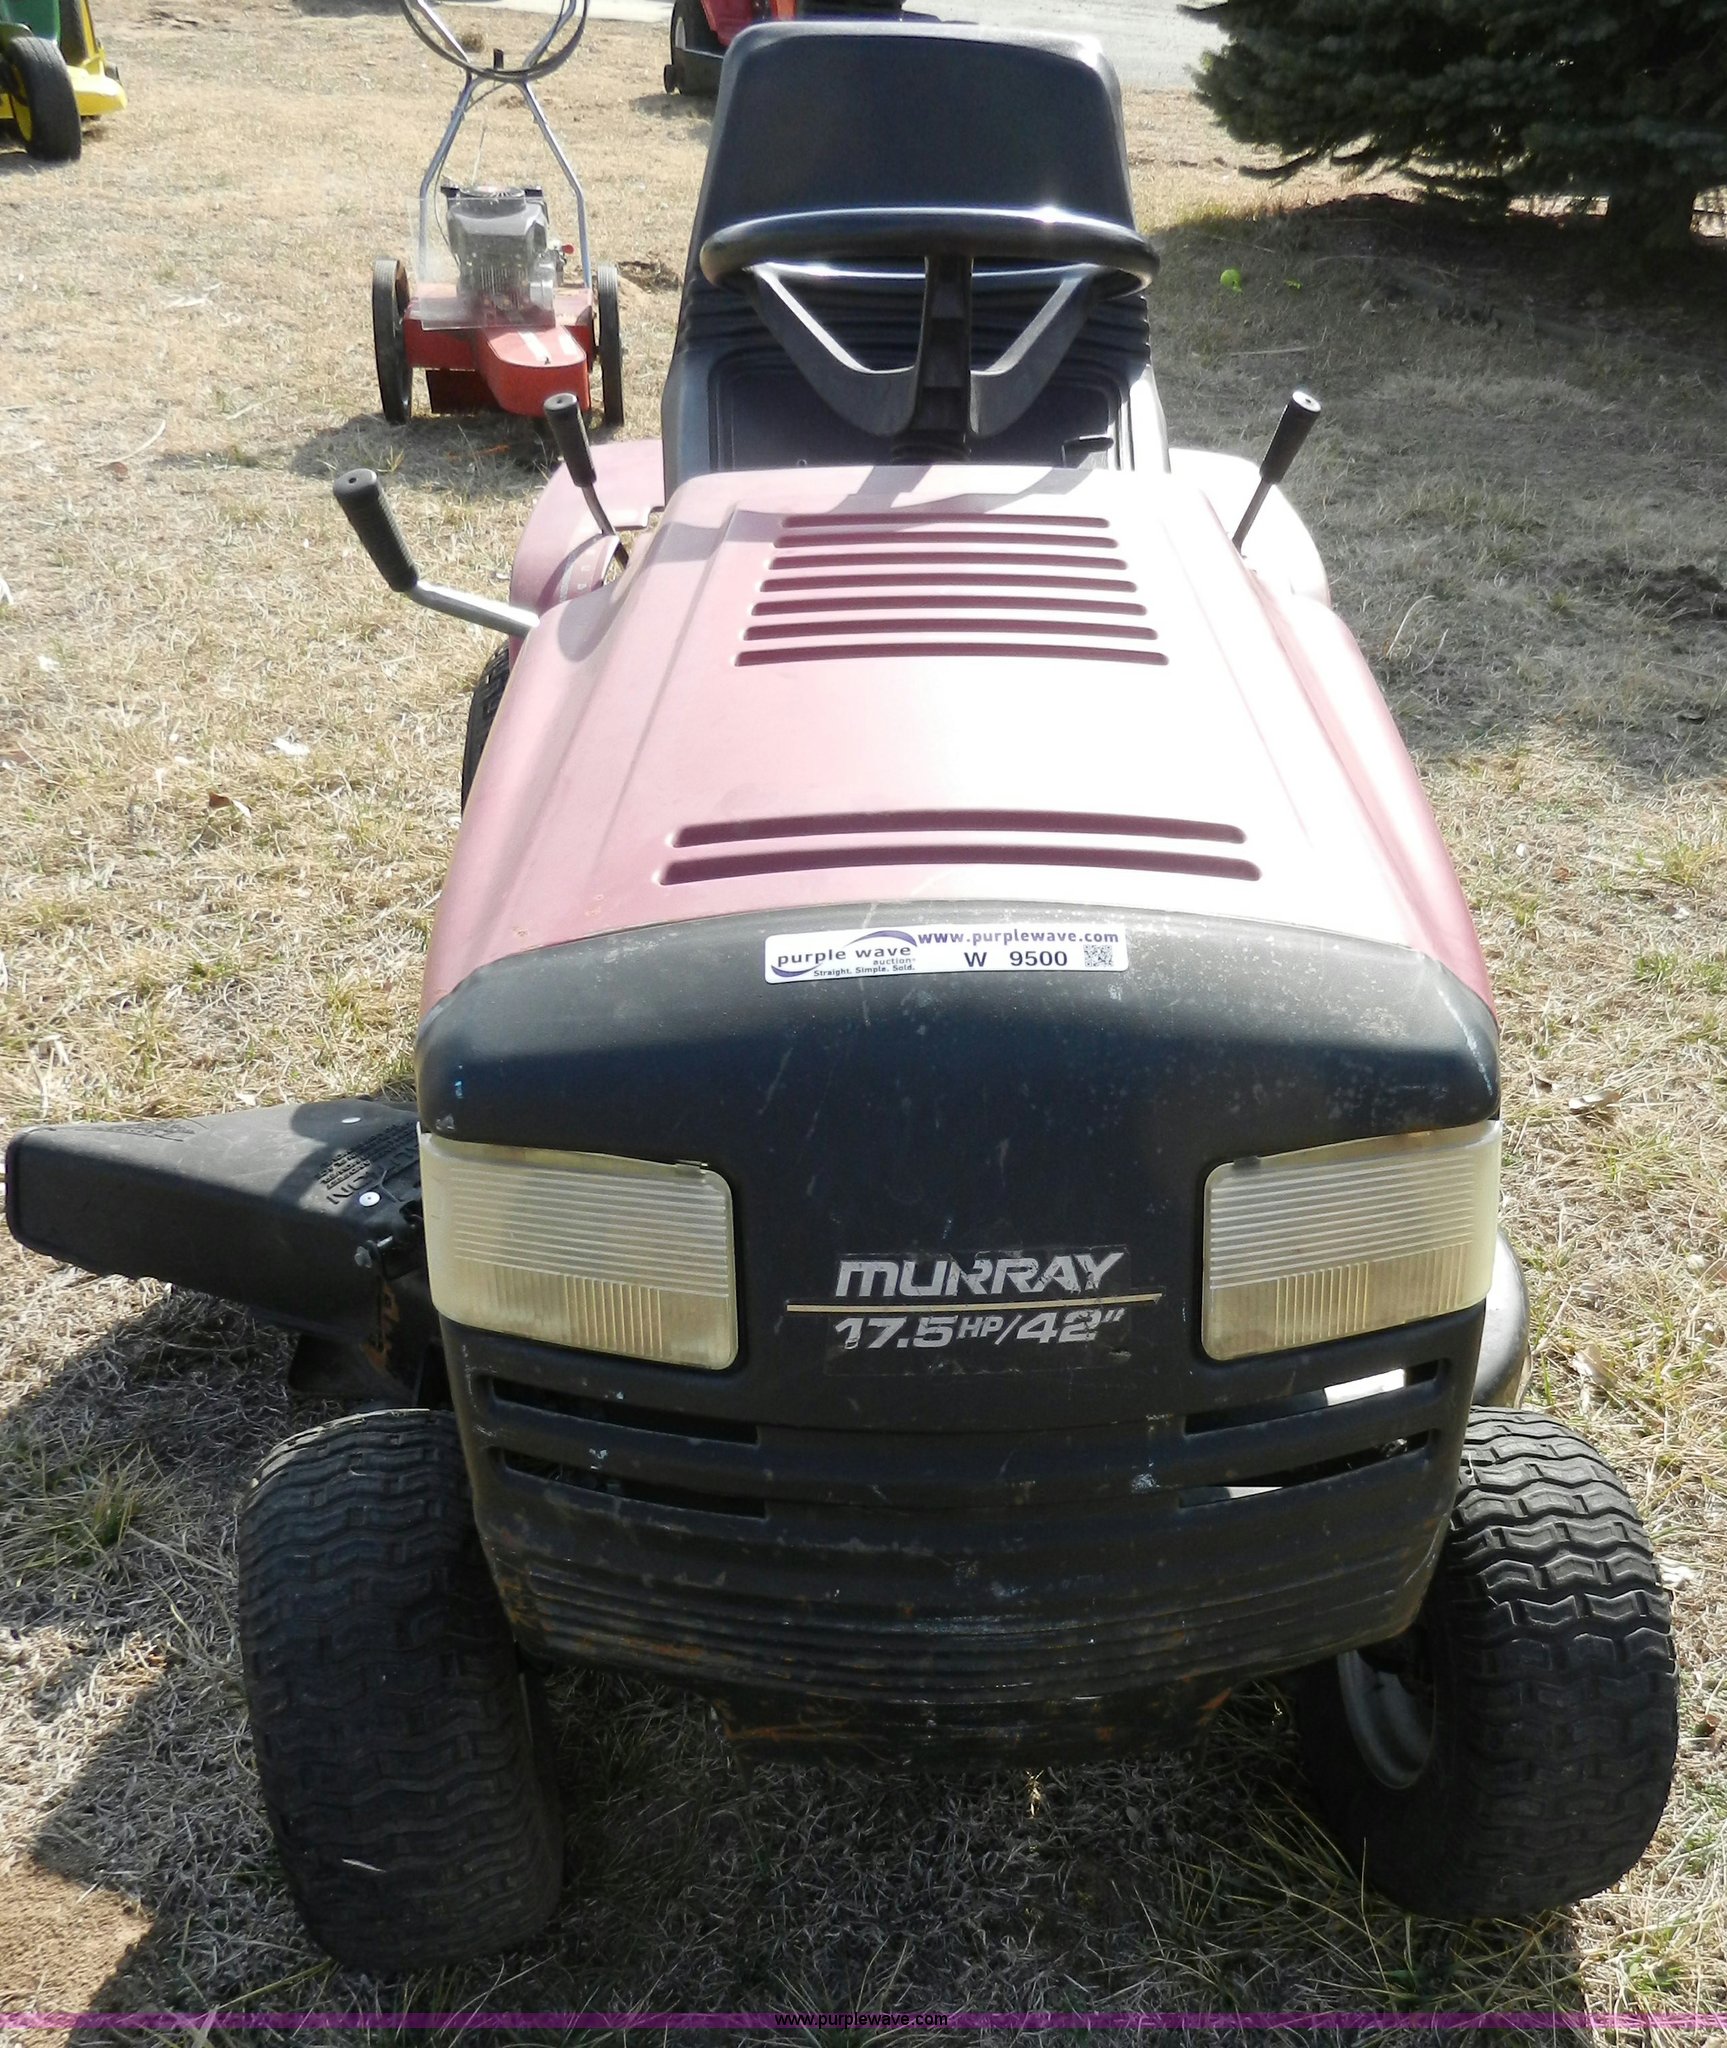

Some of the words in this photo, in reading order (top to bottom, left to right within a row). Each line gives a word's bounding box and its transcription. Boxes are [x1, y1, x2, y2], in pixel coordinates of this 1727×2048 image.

[918, 929, 1119, 946] www.purplewave.com
[777, 948, 846, 967] purple
[855, 946, 911, 959] wave
[964, 952, 987, 967] W
[1009, 951, 1068, 967] 9500
[813, 968, 852, 977] Straight.
[855, 966, 889, 975] Simple.
[893, 964, 915, 972] Sold.
[835, 1252, 1125, 1298] MURRAY
